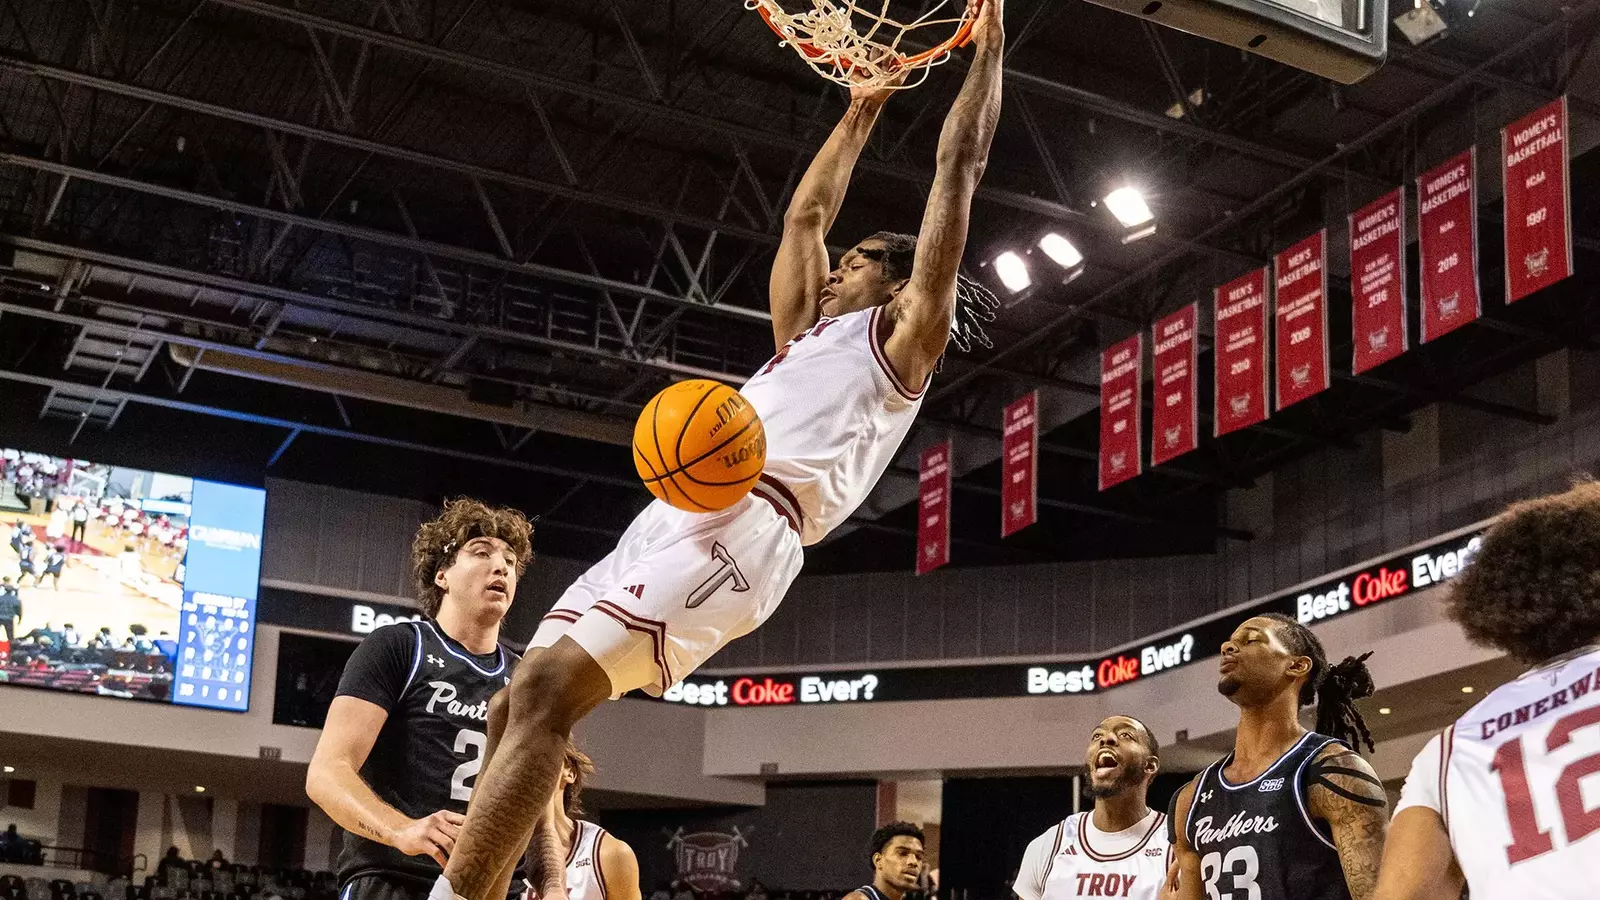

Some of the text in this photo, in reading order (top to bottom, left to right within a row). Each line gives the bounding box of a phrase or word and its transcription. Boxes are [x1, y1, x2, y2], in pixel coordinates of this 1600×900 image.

[1513, 114, 1556, 147] WOMEN'S
[1507, 128, 1562, 167] BASKETBALL
[1427, 164, 1465, 195] WOMEN'S
[1421, 178, 1470, 214] BASKETBALL
[1358, 204, 1395, 233] WOMEN'S
[1526, 207, 1547, 228] 1997
[1353, 216, 1399, 251] BASKETBALL
[1278, 258, 1321, 289] BASKETBALL
[1288, 248, 1311, 269] MEN'S
[1438, 252, 1458, 273] 2016
[1217, 293, 1262, 321] BASKETBALL
[1229, 283, 1253, 302] MEN'S
[1154, 328, 1192, 355] BASKETBALL
[1164, 319, 1184, 337] MEN'S
[1297, 582, 1350, 624] Best
[1352, 567, 1408, 605] Coke
[352, 604, 421, 633] Be
[1027, 634, 1195, 693] Best Coke Ever?
[732, 677, 795, 705] Coke
[800, 674, 879, 703] Ever?
[450, 728, 488, 802] 2
[1488, 704, 1600, 866] 12
[1195, 810, 1280, 851] Panthers
[684, 848, 730, 872] TROY
[1200, 845, 1262, 900] 33
[1076, 873, 1137, 898] TROY
